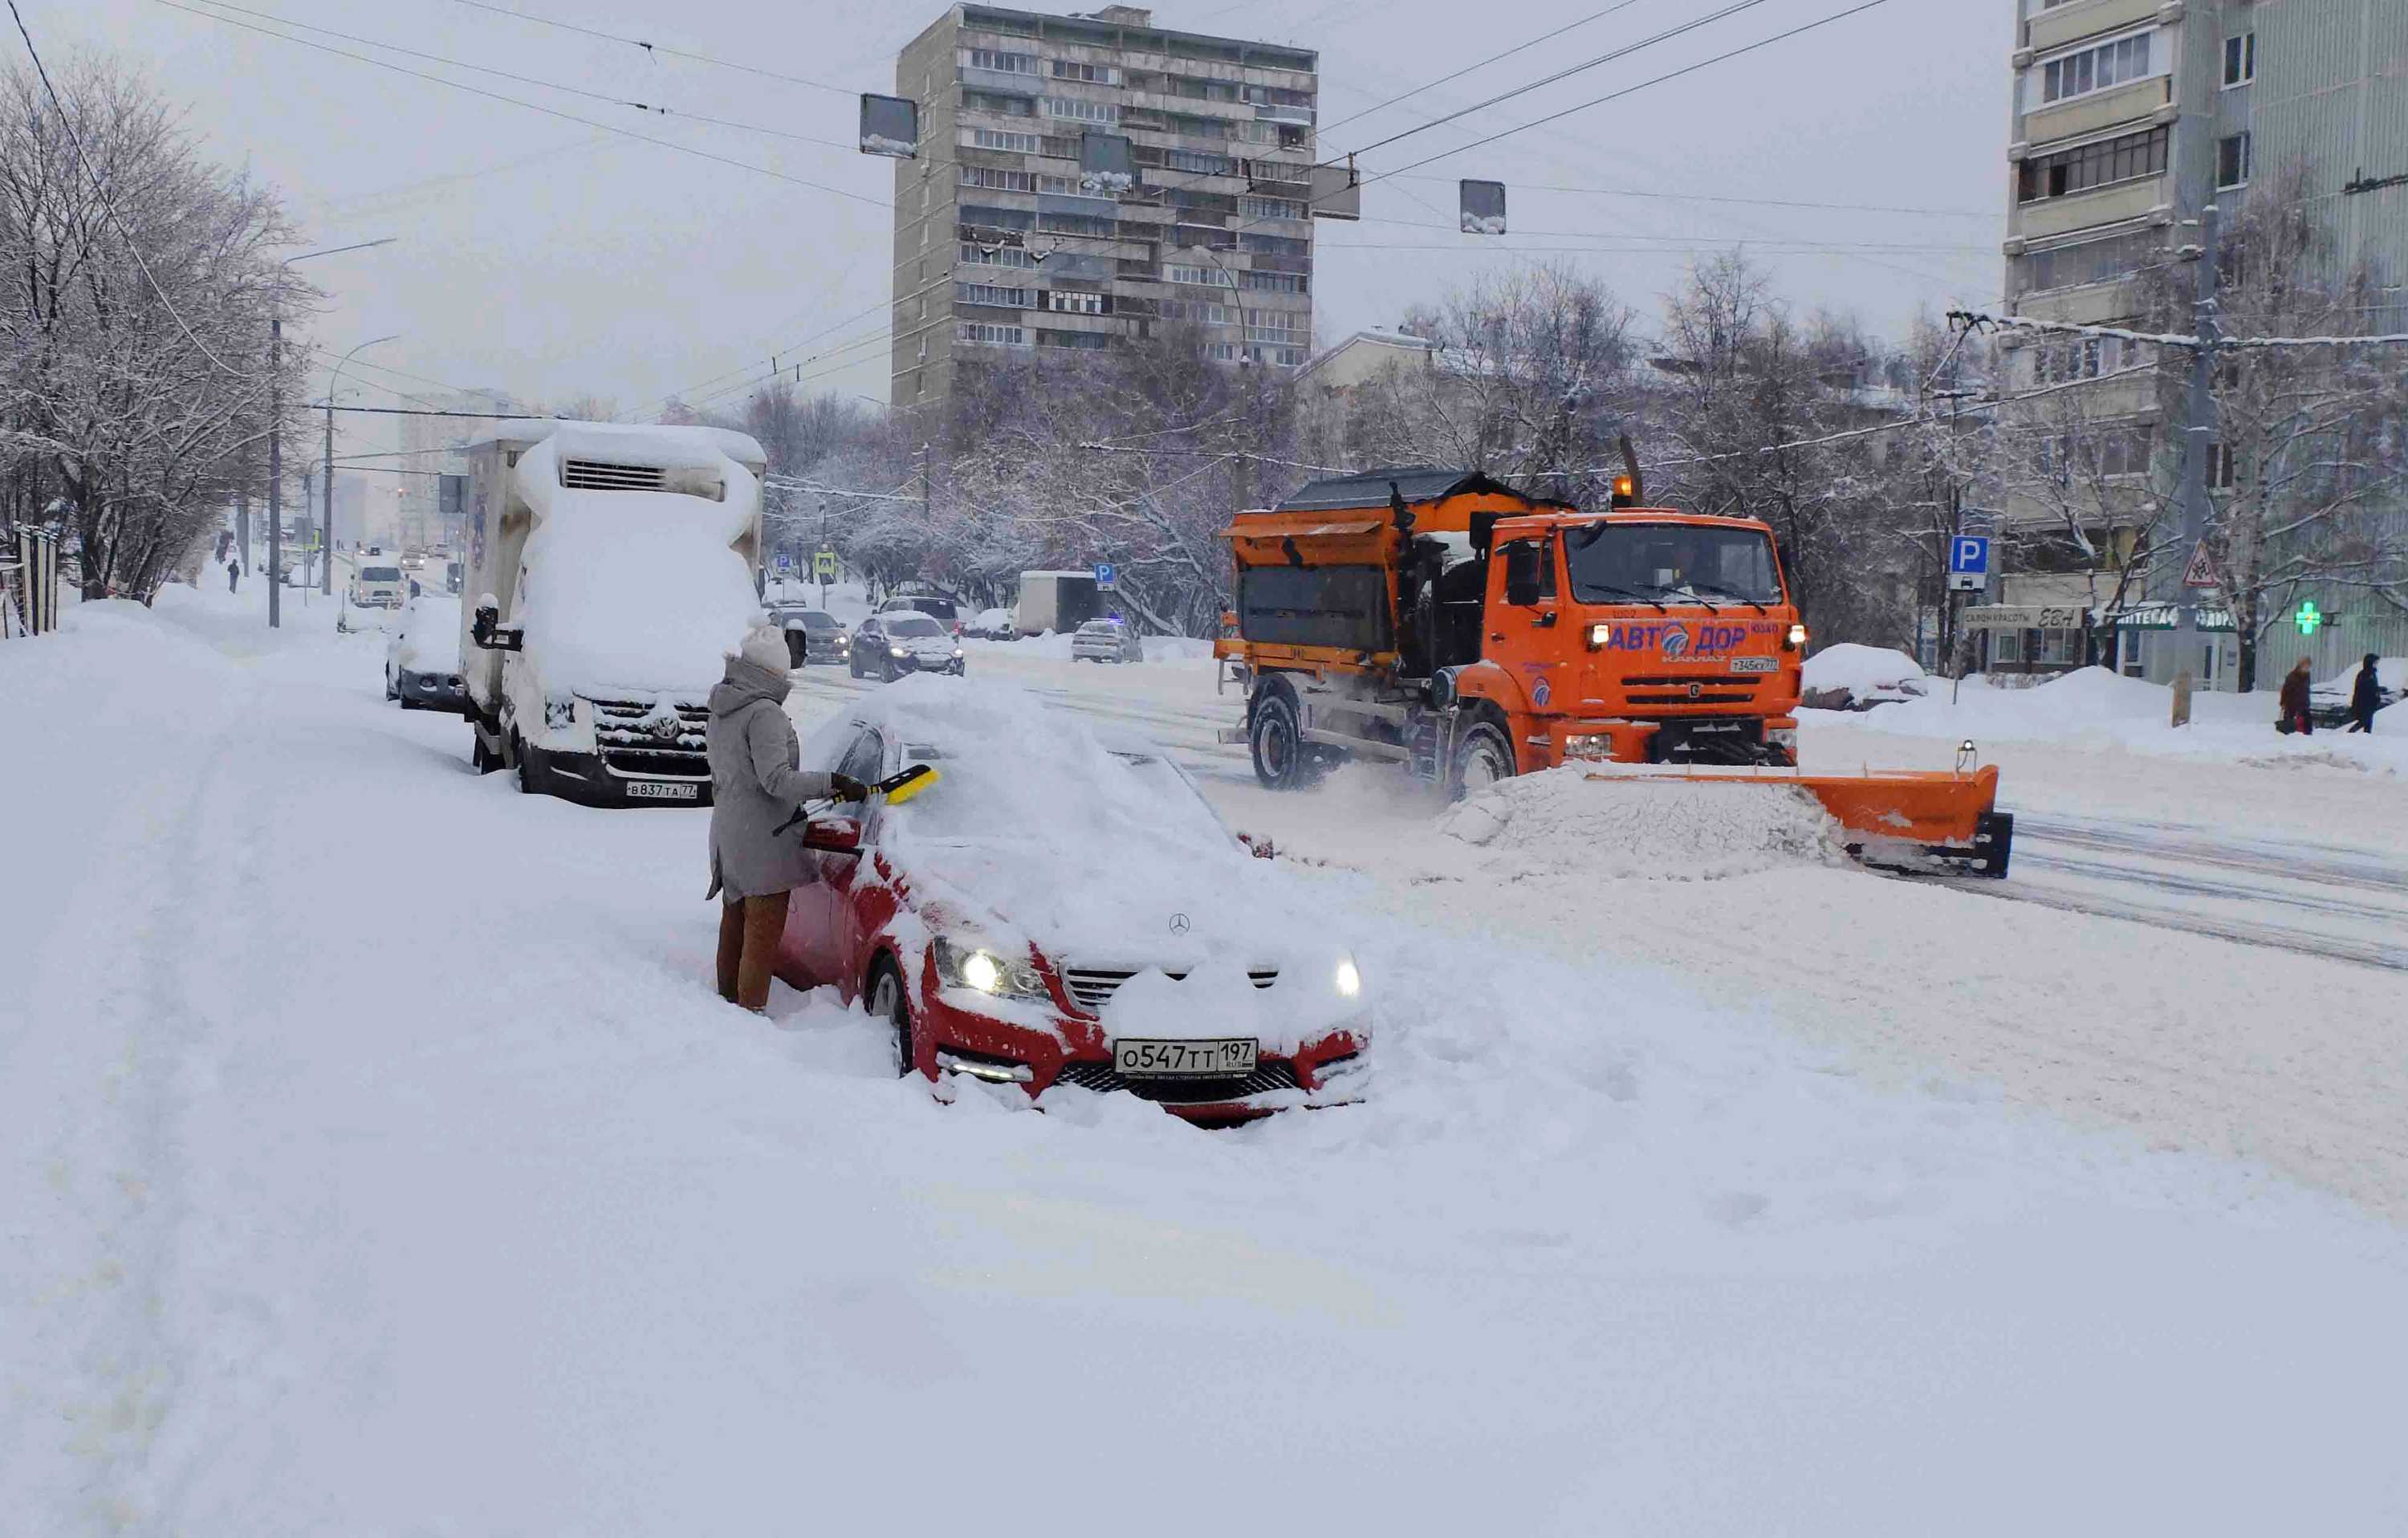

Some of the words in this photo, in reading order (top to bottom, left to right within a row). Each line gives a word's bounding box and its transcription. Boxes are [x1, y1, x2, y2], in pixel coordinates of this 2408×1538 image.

[1959, 540, 1980, 569] P
[1099, 565, 1110, 580] P
[2038, 608, 2075, 628] ЕВА
[1220, 1042, 1251, 1061] 197
